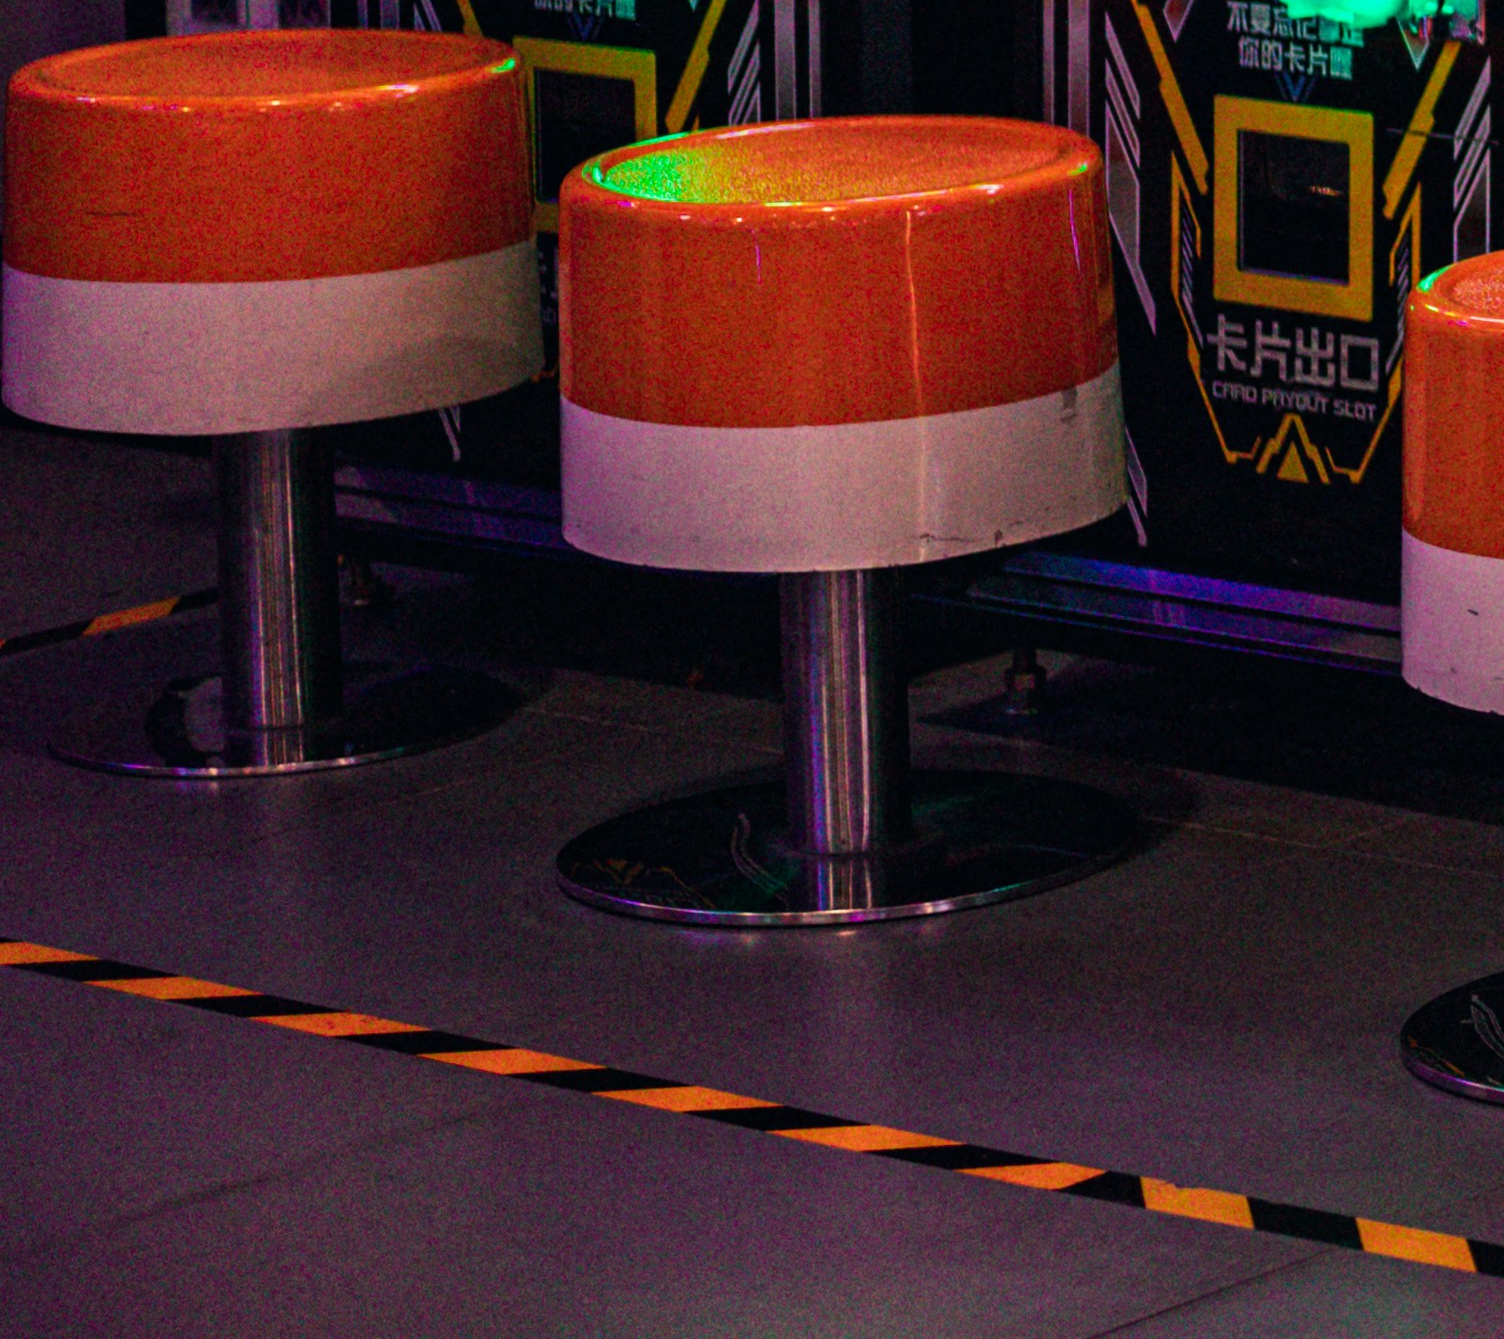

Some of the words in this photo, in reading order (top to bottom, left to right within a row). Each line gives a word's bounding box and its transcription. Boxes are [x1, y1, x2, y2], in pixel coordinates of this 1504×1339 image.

[1205, 312, 1381, 393] 卡片出口
[1211, 380, 1258, 403] CARD
[1261, 386, 1330, 415] PAYOUT
[1332, 398, 1377, 423] SLOT
